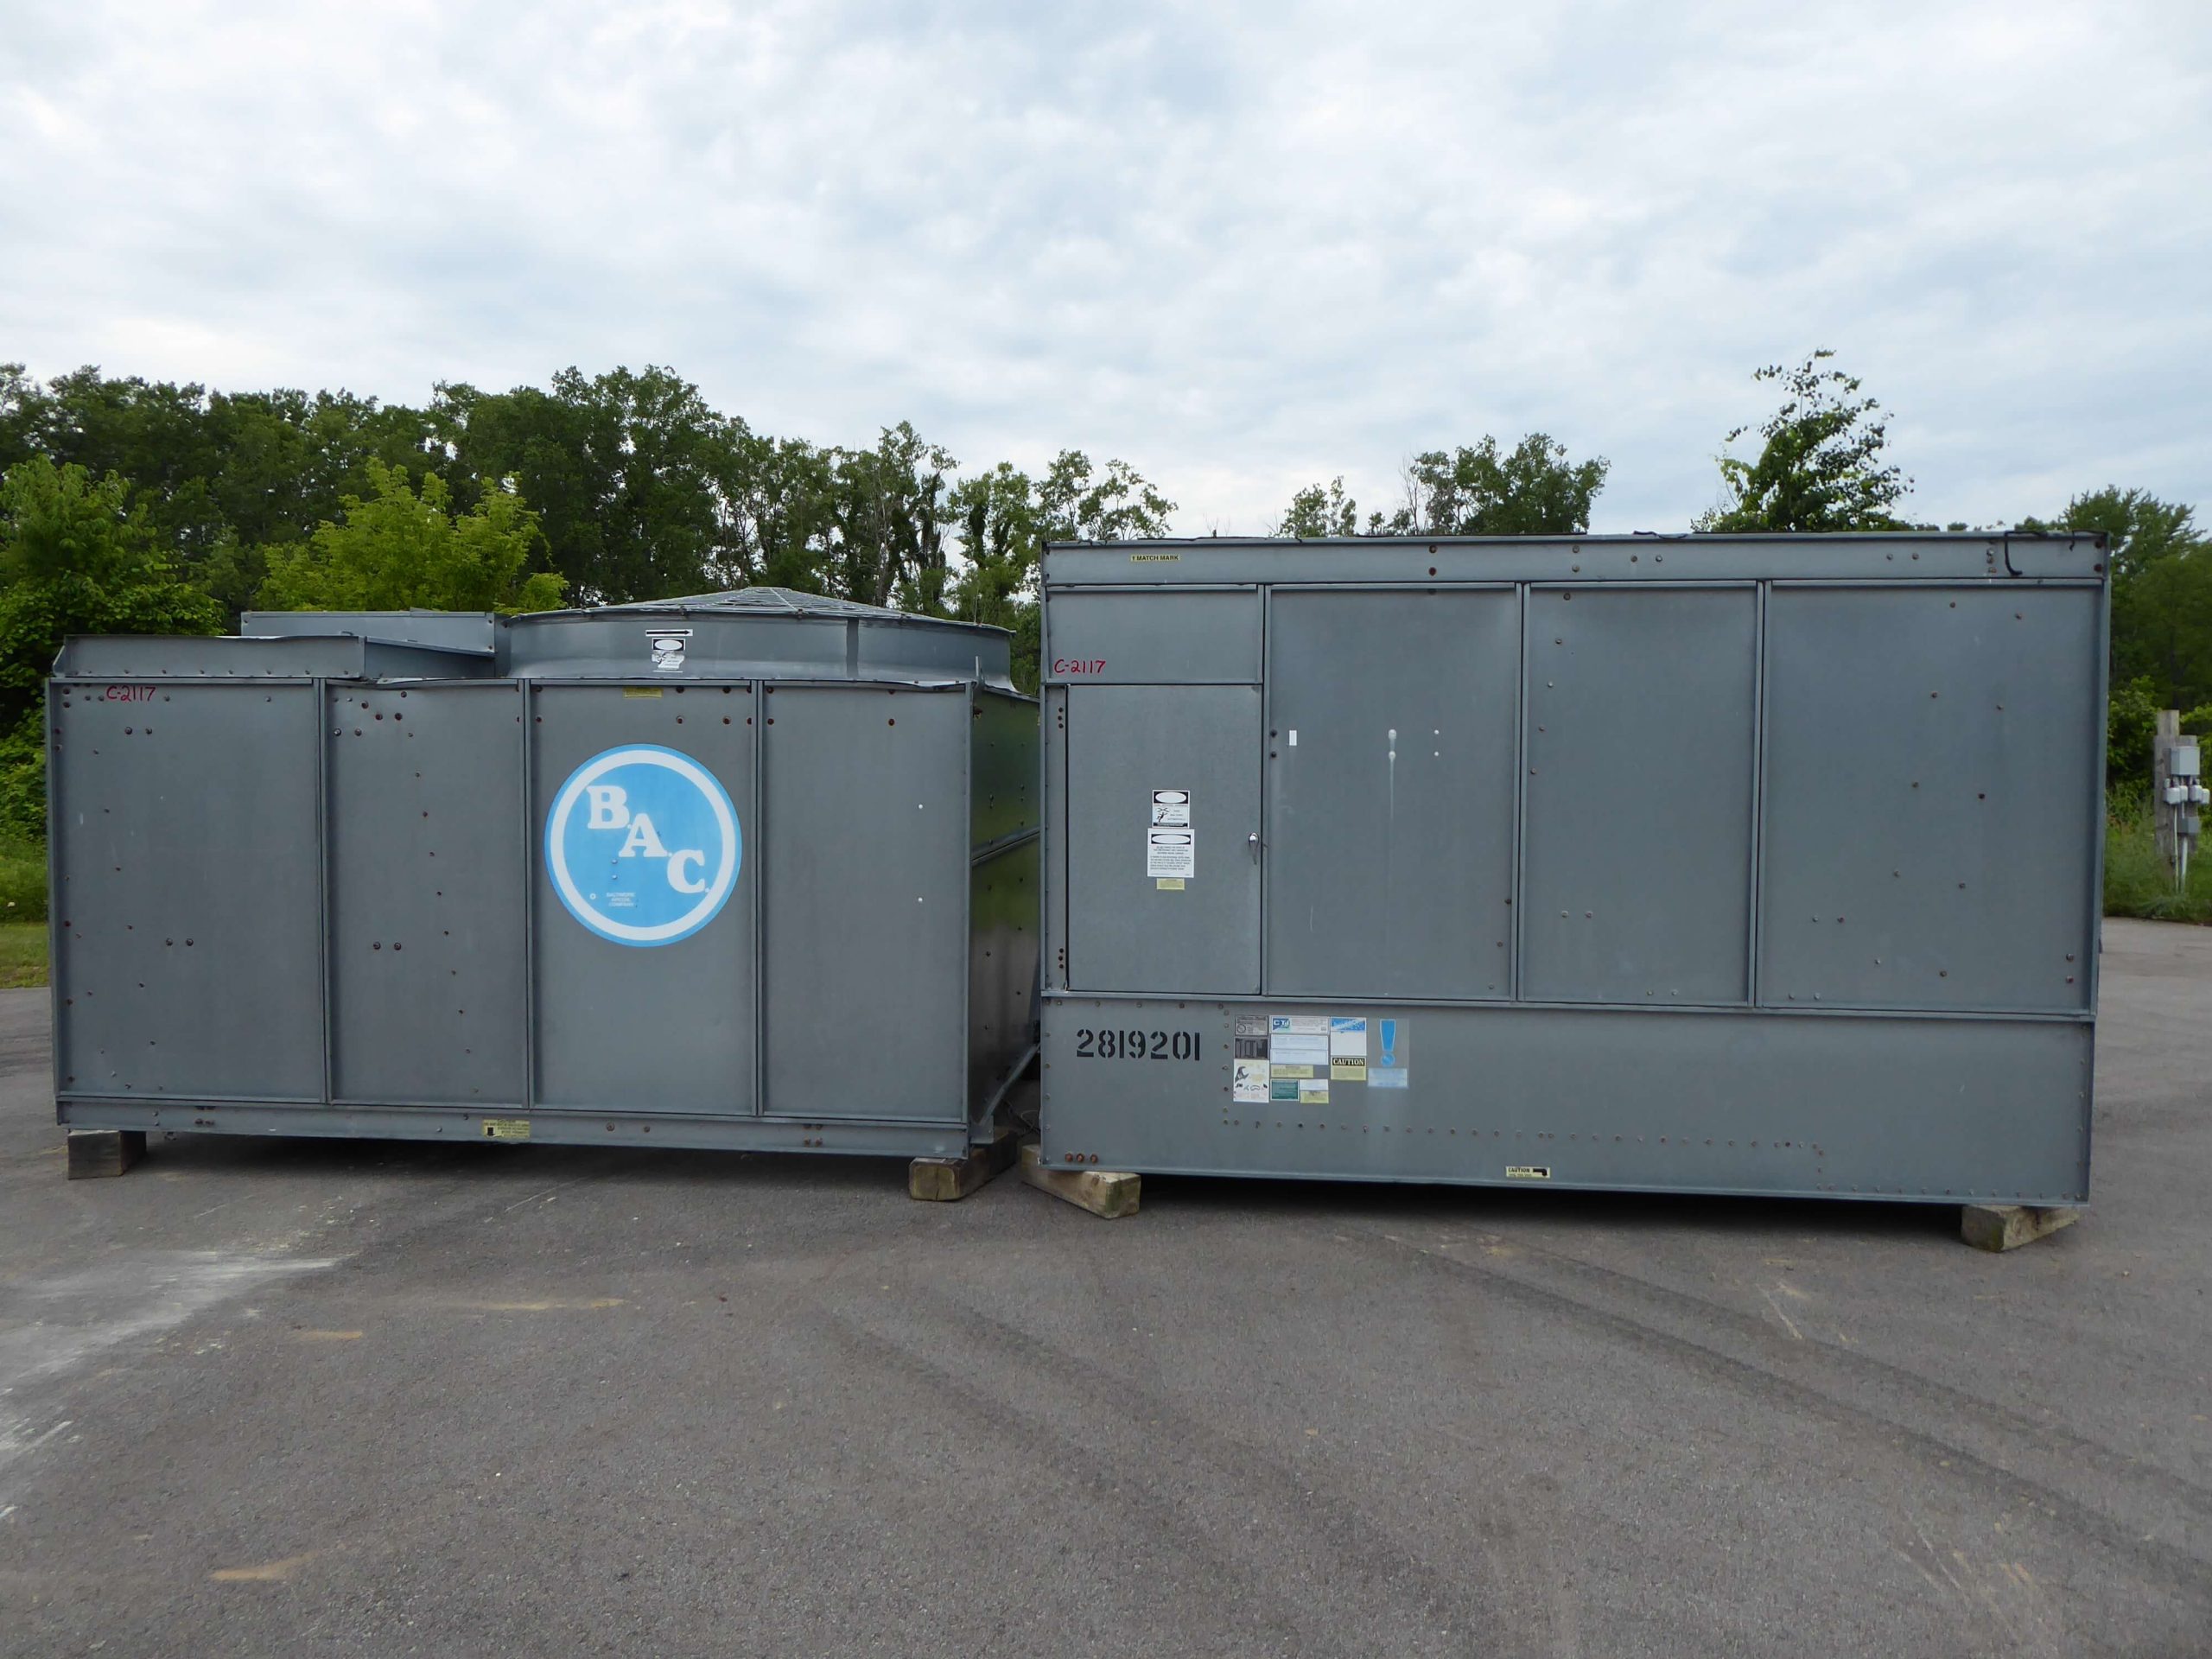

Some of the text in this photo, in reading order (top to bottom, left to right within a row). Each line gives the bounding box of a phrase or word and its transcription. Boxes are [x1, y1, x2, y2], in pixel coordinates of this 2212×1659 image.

[1054, 659, 1106, 673] C-2117
[106, 685, 156, 702] C-2117
[1077, 1029, 1200, 1061] 2819201
